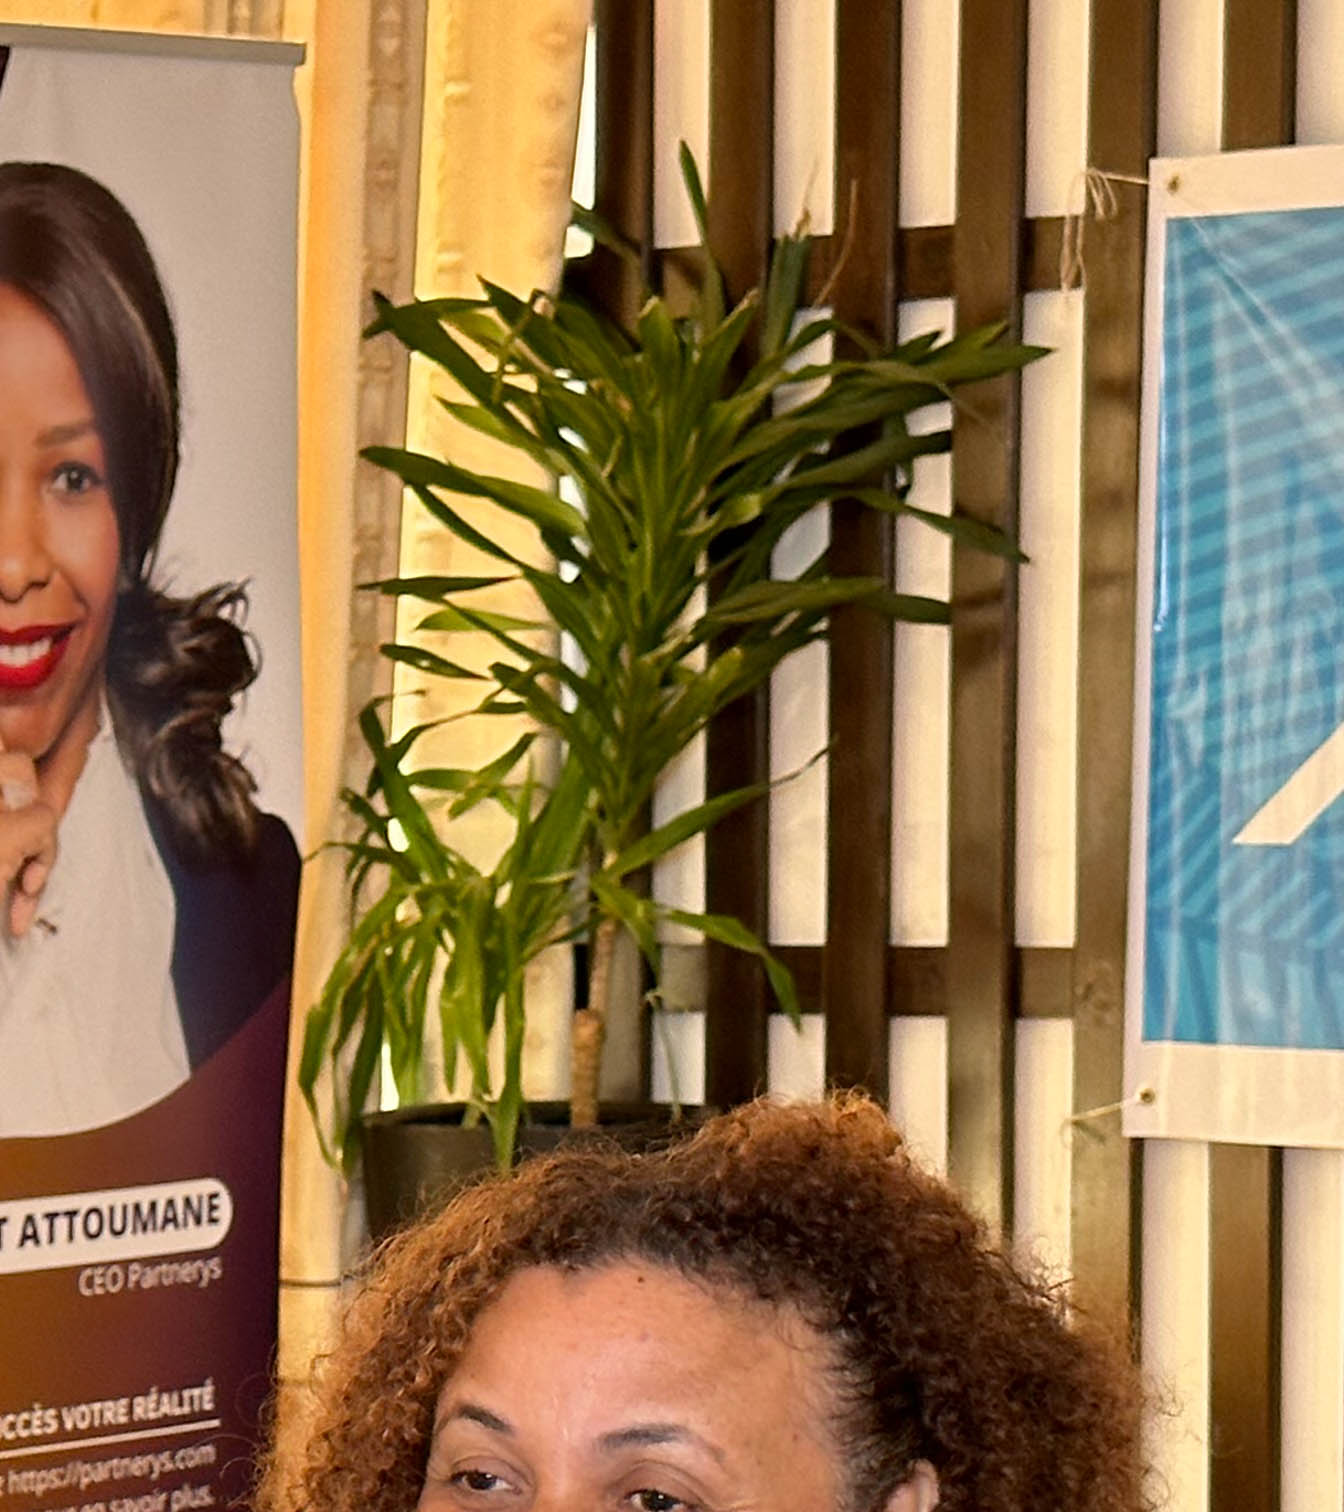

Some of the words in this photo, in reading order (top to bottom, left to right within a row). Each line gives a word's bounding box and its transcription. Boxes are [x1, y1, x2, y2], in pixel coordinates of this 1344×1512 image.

[18, 1191, 221, 1249] ATTOUMANE
[78, 1265, 123, 1297] CEO
[127, 1257, 223, 1290] Partnerys
[62, 1398, 130, 1432] VOTRE
[132, 1377, 216, 1421] RÉALITÉ
